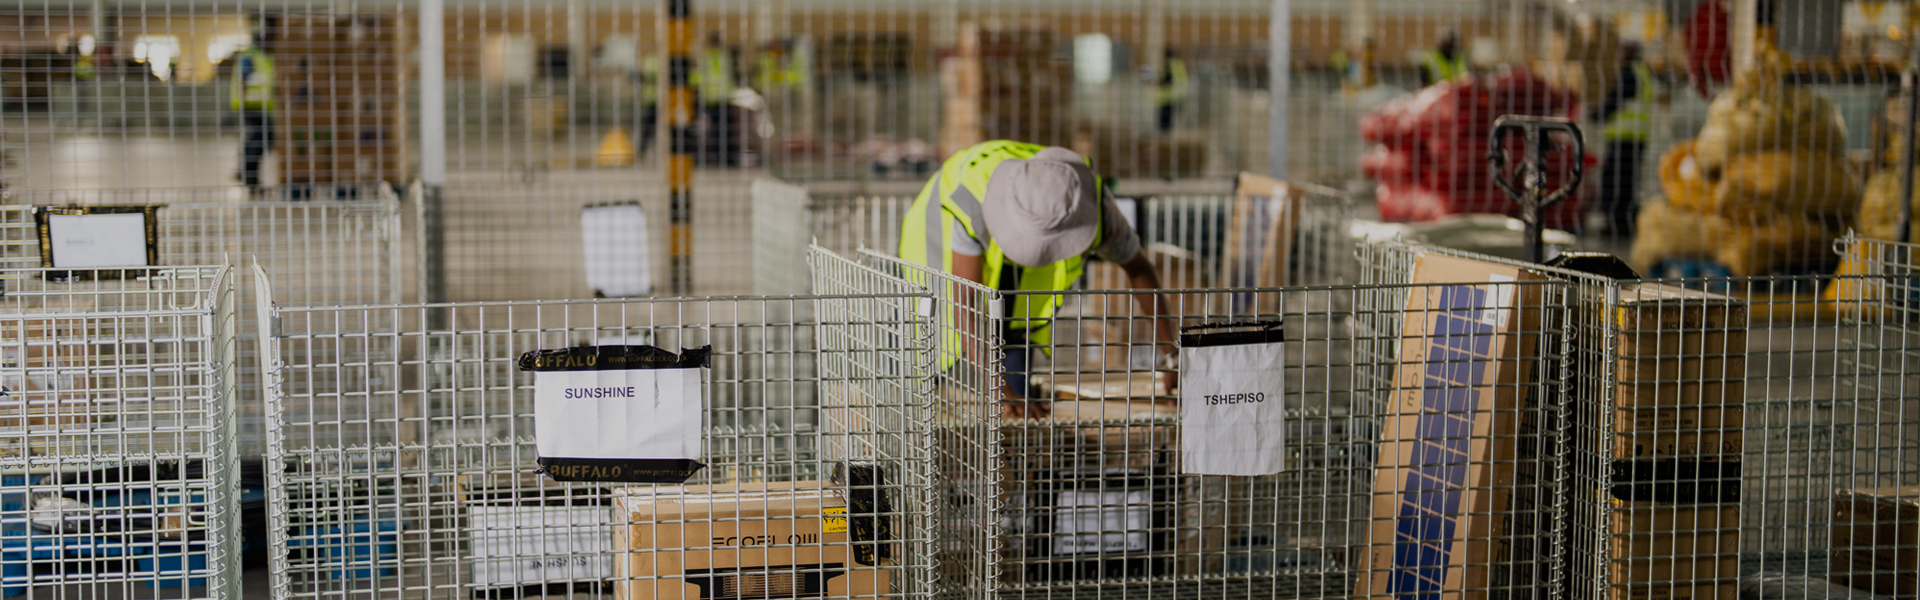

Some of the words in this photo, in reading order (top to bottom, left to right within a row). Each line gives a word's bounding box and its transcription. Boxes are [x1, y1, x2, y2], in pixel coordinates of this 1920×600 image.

[564, 386, 636, 399] SUNSHINE
[1203, 392, 1265, 406] TSHEPISO
[550, 464, 622, 478] BUFFALO
